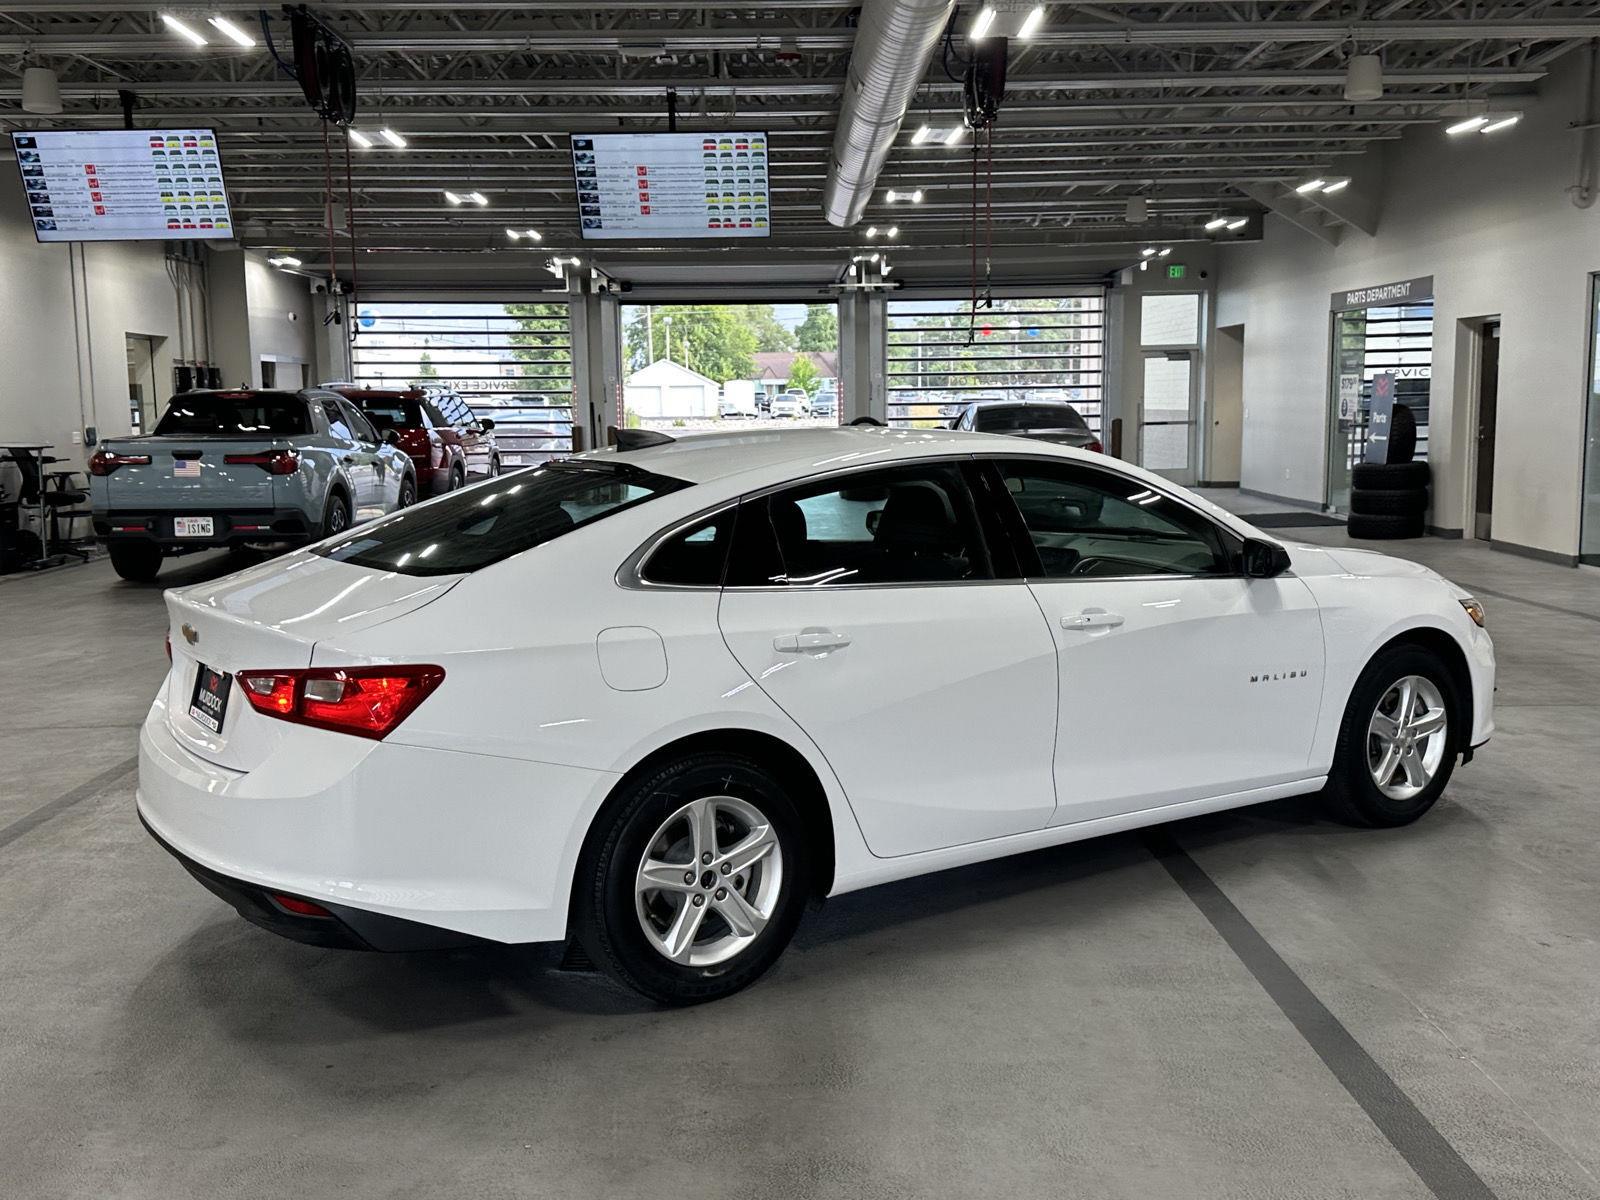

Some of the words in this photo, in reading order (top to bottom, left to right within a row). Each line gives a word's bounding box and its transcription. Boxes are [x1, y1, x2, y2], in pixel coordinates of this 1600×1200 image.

[1346, 291, 1366, 304] PARTS
[1366, 282, 1411, 302] DEPARTMENT
[1372, 411, 1387, 423] Parts
[1249, 669, 1308, 682] MALIBU
